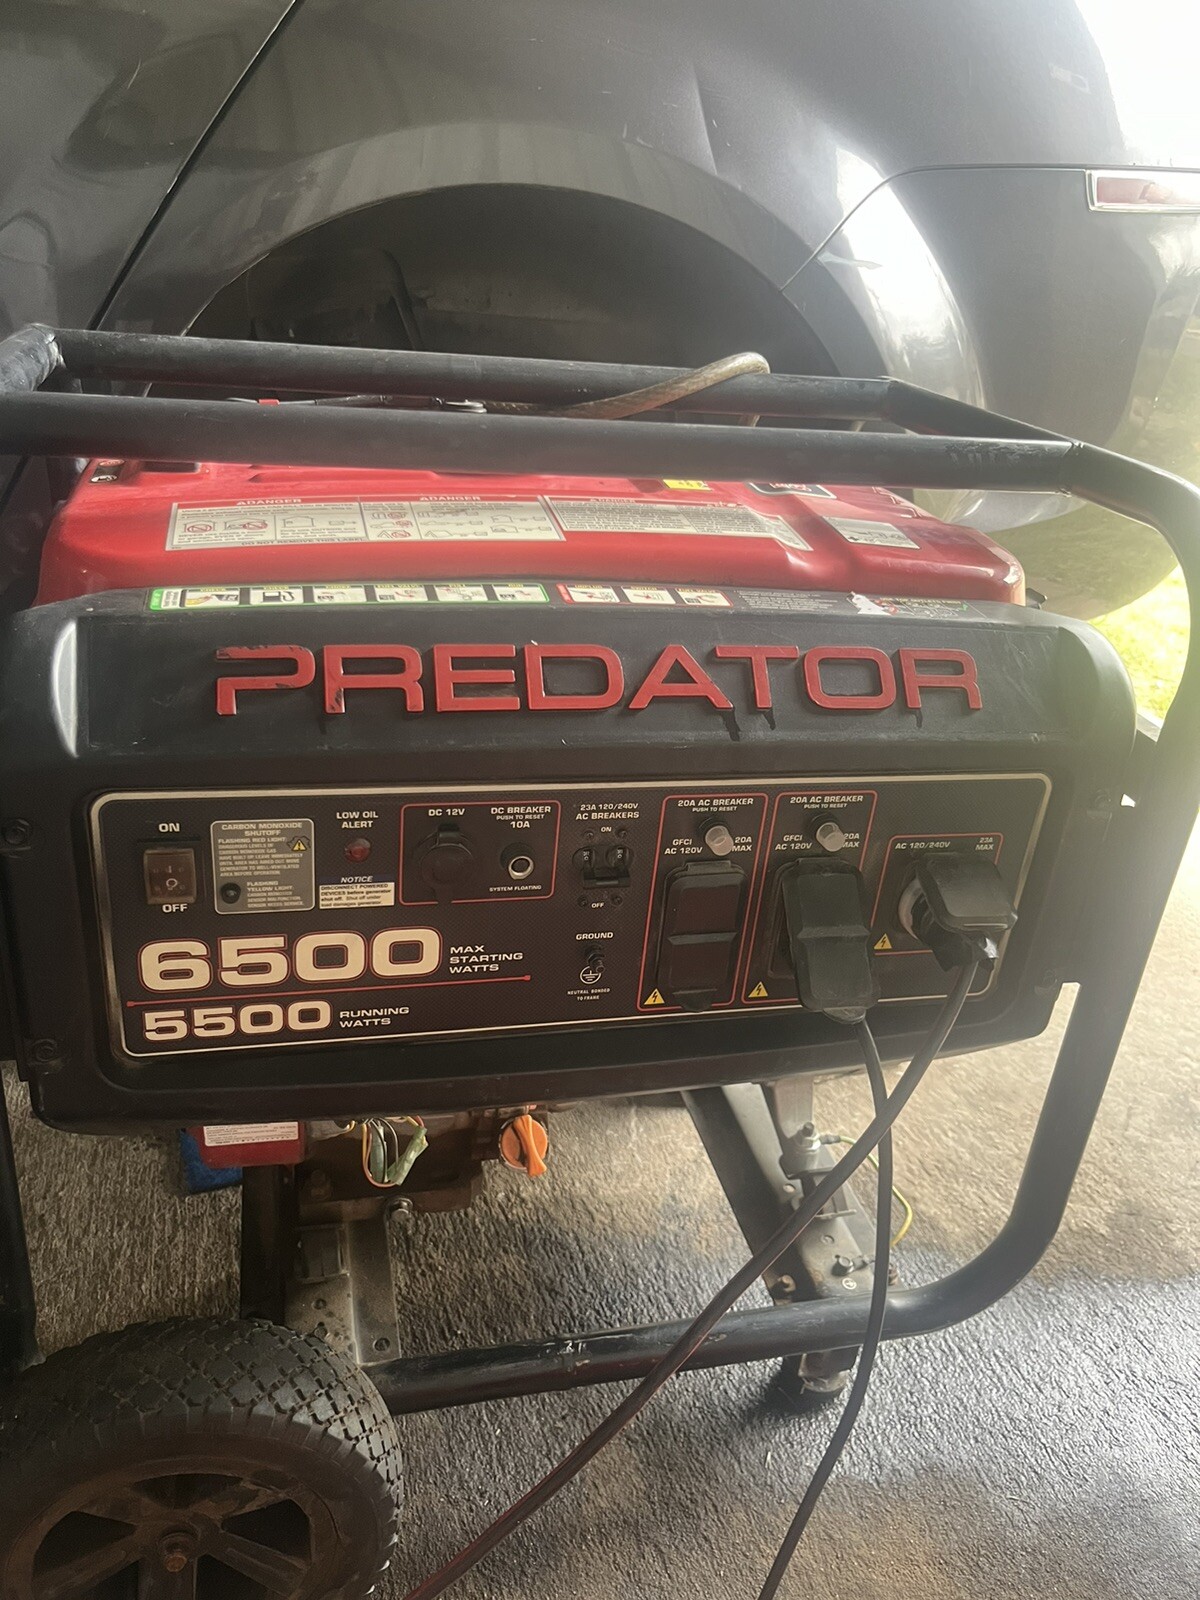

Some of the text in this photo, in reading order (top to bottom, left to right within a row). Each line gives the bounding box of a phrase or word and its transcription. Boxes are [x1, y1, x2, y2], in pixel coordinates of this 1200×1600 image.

[216, 643, 982, 716] PREDATOR
[336, 811, 360, 819] LOW
[159, 822, 180, 832] ON
[341, 820, 373, 829] ALERT
[162, 903, 188, 913] OFF
[576, 932, 614, 940] GROUND
[450, 945, 485, 954] MAX
[140, 928, 442, 991] 6500
[450, 952, 523, 964] STARTING
[450, 964, 499, 974] WATTS
[340, 1006, 410, 1018] RUNNING
[143, 1001, 330, 1040] 5500
[339, 1018, 391, 1028] WATTS
